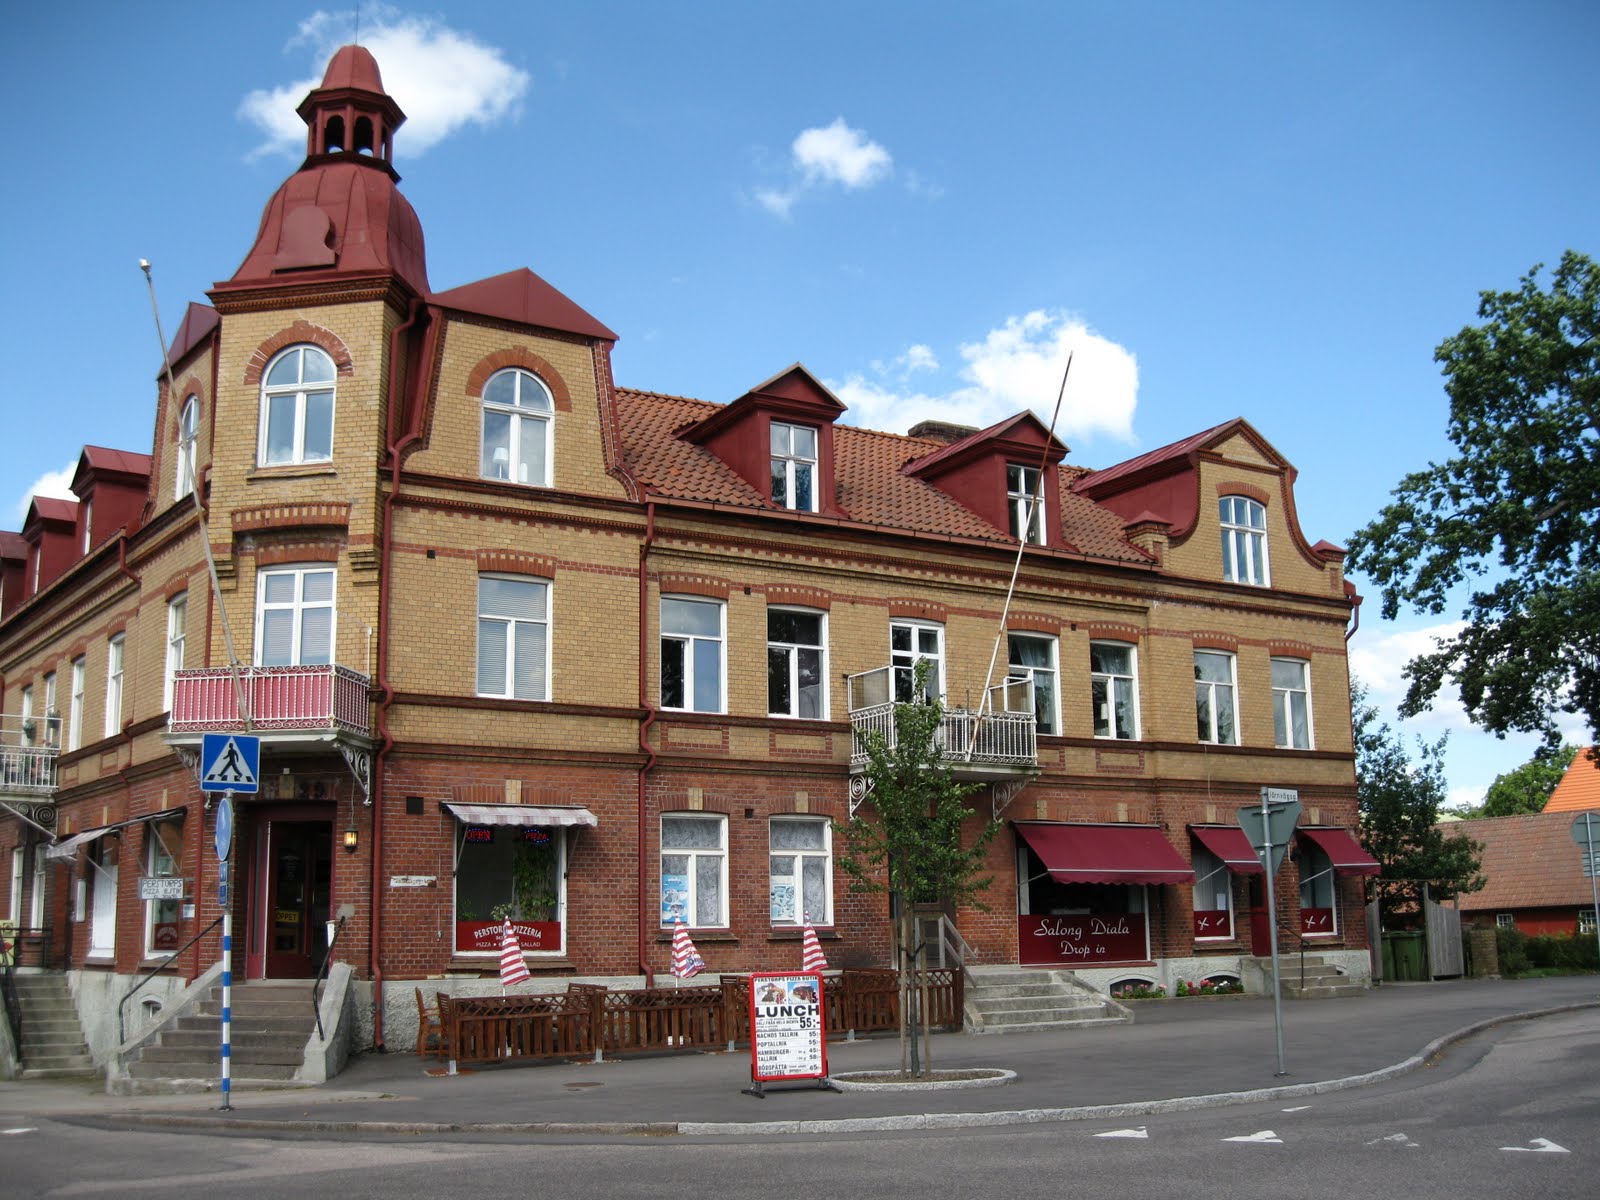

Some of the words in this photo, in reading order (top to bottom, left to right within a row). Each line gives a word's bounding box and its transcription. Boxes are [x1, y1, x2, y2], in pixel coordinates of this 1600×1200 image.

[466, 830, 490, 840] OPEN
[142, 880, 182, 888] PERSTORPS
[514, 926, 542, 938] PIZZERIA
[1034, 918, 1082, 940] Salong
[1090, 918, 1130, 934] Diala
[1060, 940, 1090, 958] Drop
[1096, 944, 1106, 954] in
[756, 1004, 820, 1018] LUNCH
